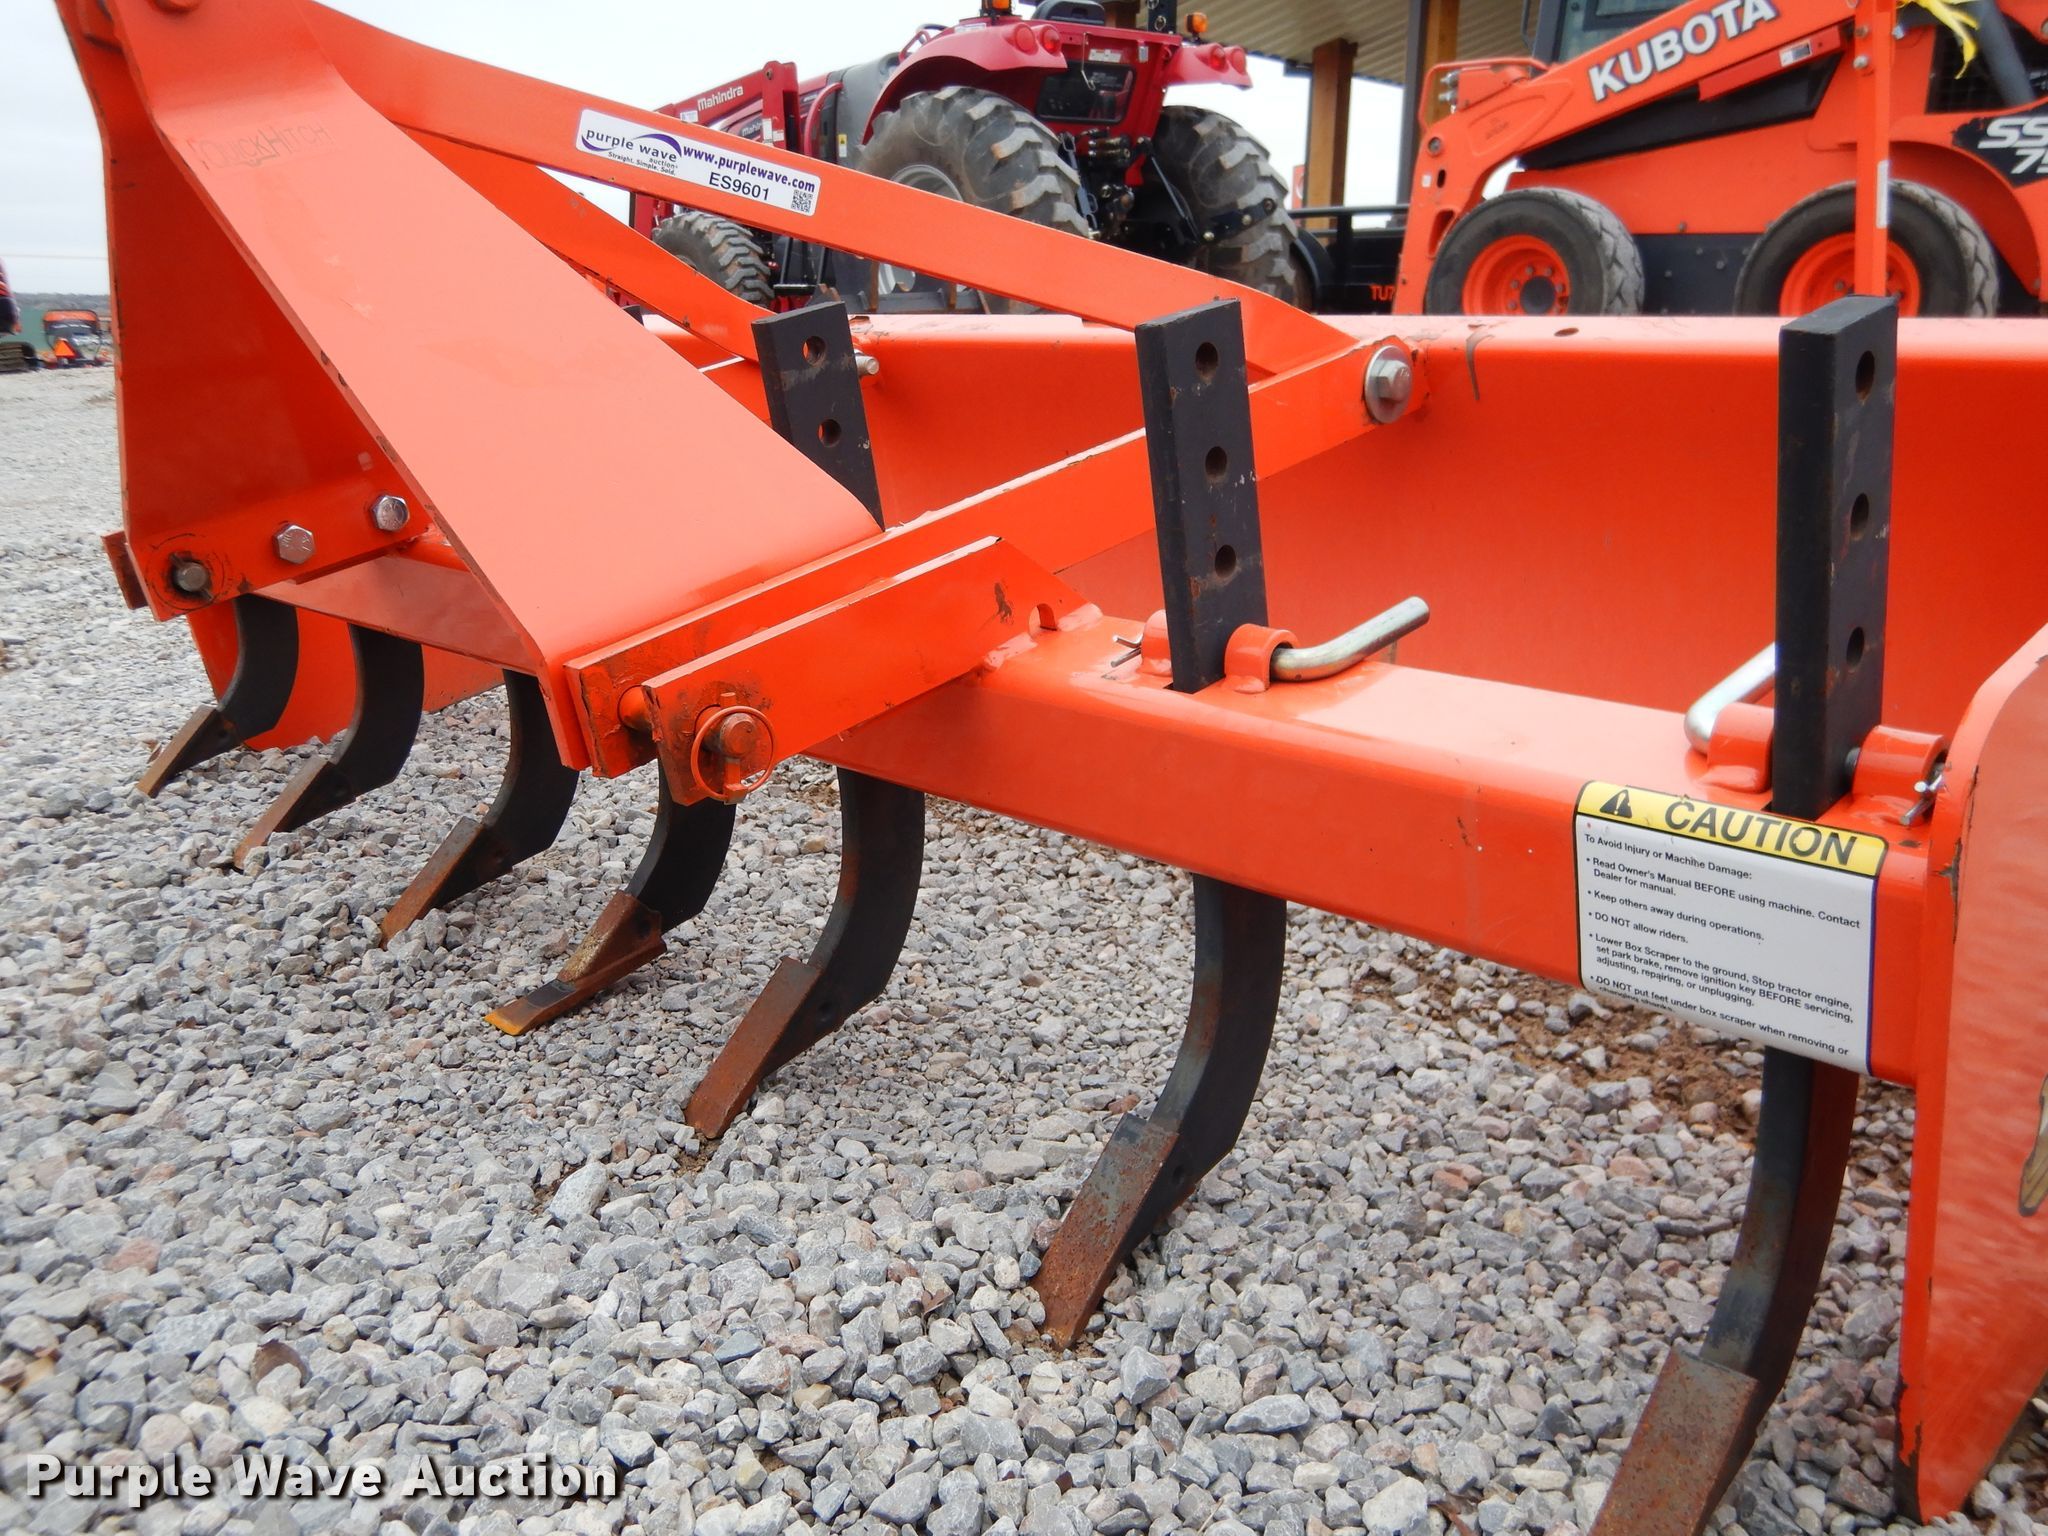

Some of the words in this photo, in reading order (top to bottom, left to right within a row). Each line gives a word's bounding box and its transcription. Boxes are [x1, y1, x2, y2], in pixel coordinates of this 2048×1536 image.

[1588, 0, 1777, 102] KUBOTA
[697, 86, 744, 111] Mahindra
[586, 129, 634, 150] purple
[639, 145, 677, 162] wave
[683, 146, 815, 193] www.purplewave.com
[709, 172, 769, 200] ES9601
[1585, 834, 1595, 844] To
[1597, 838, 1622, 850] Avoid
[1625, 844, 1650, 858] Injury
[1653, 850, 1662, 858] or
[1665, 852, 1705, 869] Machine
[1708, 862, 1752, 880] Damage:
[1665, 800, 1857, 865] CAUTION
[1593, 857, 1616, 870] Read
[1618, 864, 1654, 880] Owner's
[1658, 873, 1692, 888] Manual
[1694, 881, 1736, 899] BEFORE
[1738, 893, 1766, 908] using
[1768, 900, 1815, 918] machine.
[1818, 911, 1860, 928] Contact
[1594, 868, 1622, 882] Dealer
[1625, 876, 1638, 886] for
[1640, 882, 1676, 896] manual.
[1594, 890, 1617, 904] Keep
[1619, 897, 1648, 911] others
[1650, 906, 1674, 919] away
[1676, 911, 1706, 927] during
[1709, 920, 1764, 940] operations.
[1594, 912, 1608, 922] DO
[1611, 915, 1630, 928] NOT
[1633, 922, 1657, 935] allow
[1660, 928, 1688, 944] riders.
[1596, 933, 1622, 947] Lower
[1625, 941, 1642, 953] Box
[1644, 946, 1680, 964] Scraper
[1682, 957, 1692, 967] to
[1694, 958, 1710, 972] the
[1752, 975, 1775, 990] Stop
[1778, 983, 1812, 999] tractor
[1596, 956, 1639, 976] adjusting,
[1642, 968, 1684, 988] repairing,
[1686, 981, 1696, 990] or
[1698, 984, 1754, 1006] unplugging.
[1596, 946, 1610, 955] set
[1612, 950, 1632, 962] park
[1634, 954, 1662, 970] brake,
[1664, 964, 1699, 980] remove
[1701, 973, 1736, 990] ignition
[1739, 983, 1756, 997] key
[1759, 988, 1802, 1008] BEFORE
[1804, 1002, 1854, 1024] servicing,
[1596, 975, 1610, 986] DO
[1612, 980, 1632, 992] NOT
[1634, 988, 1650, 998] put
[1652, 991, 1668, 1004] feet
[1670, 998, 1697, 1011] under
[1700, 1005, 1717, 1018] box
[1720, 1012, 1756, 1028] scraper
[1759, 1023, 1786, 1038] when
[1788, 1032, 1835, 1053] removing
[1838, 1047, 1849, 1056] or
